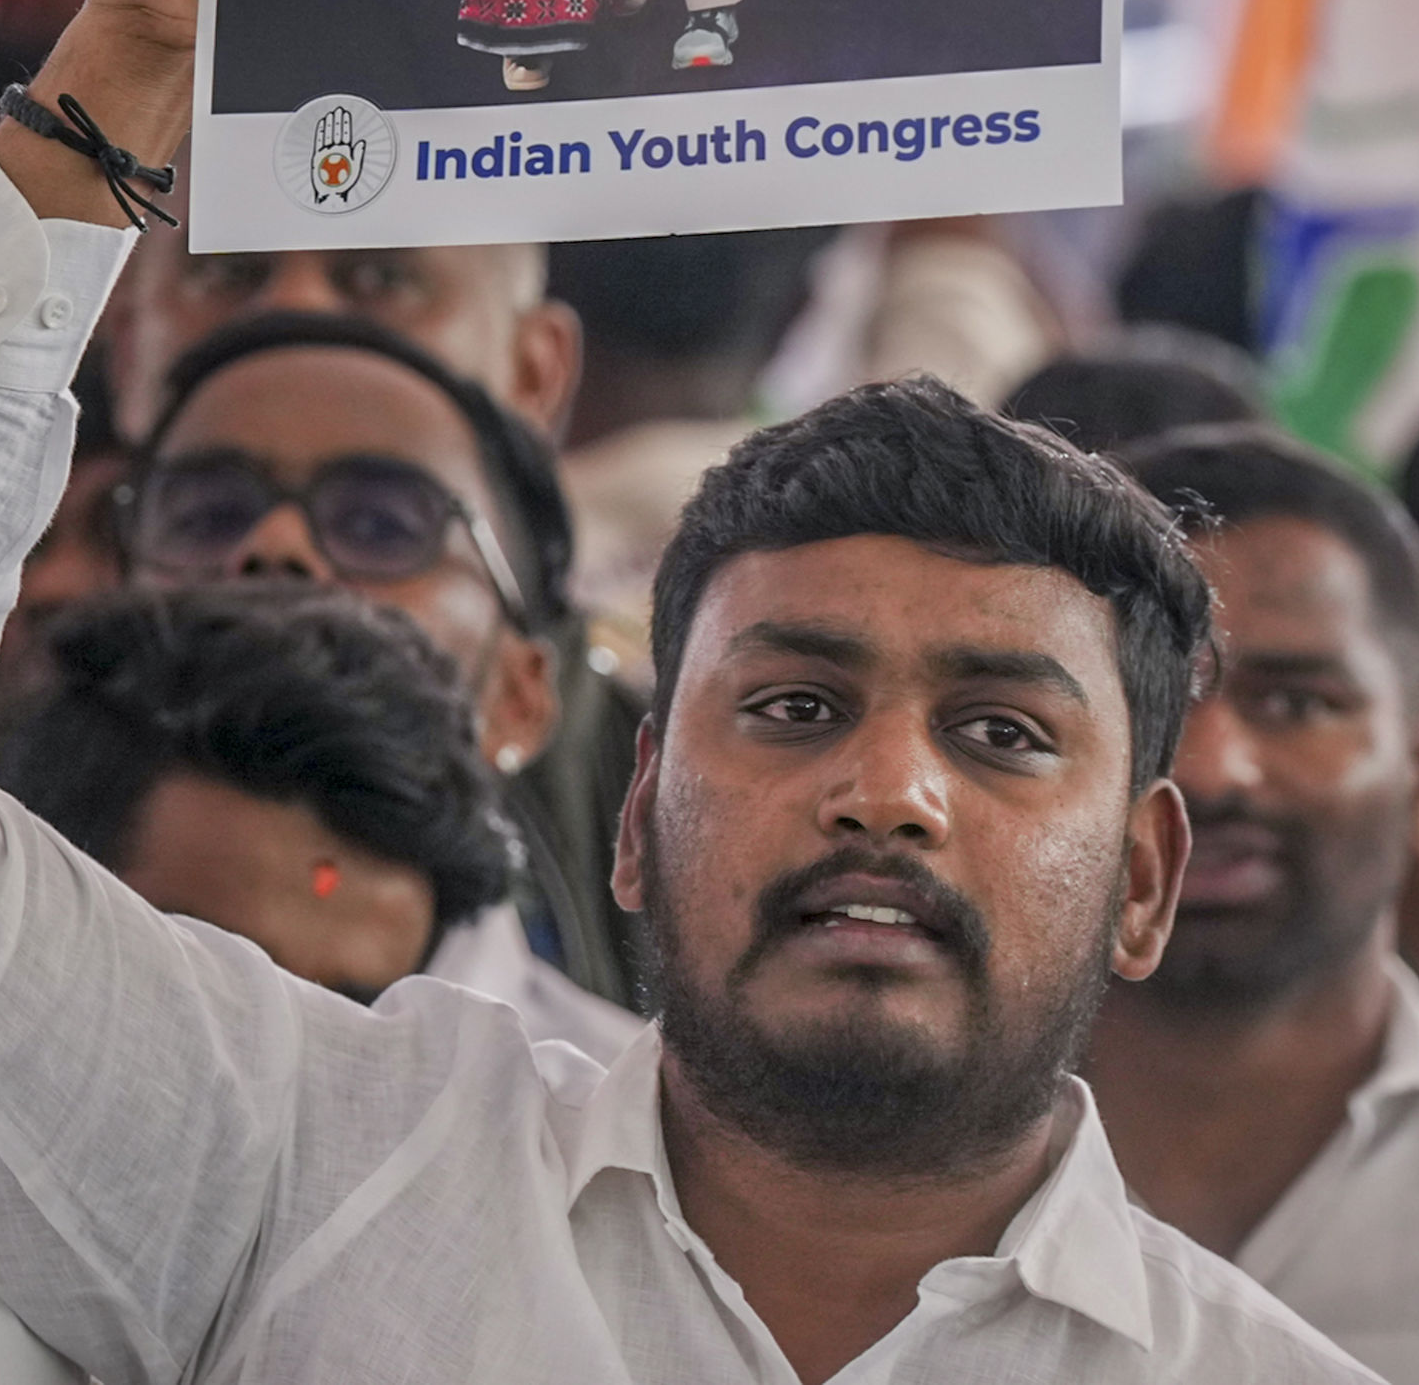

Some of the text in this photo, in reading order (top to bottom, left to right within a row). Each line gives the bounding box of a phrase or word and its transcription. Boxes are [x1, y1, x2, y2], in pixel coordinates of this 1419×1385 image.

[416, 110, 1042, 181] Indian Youth Congress
